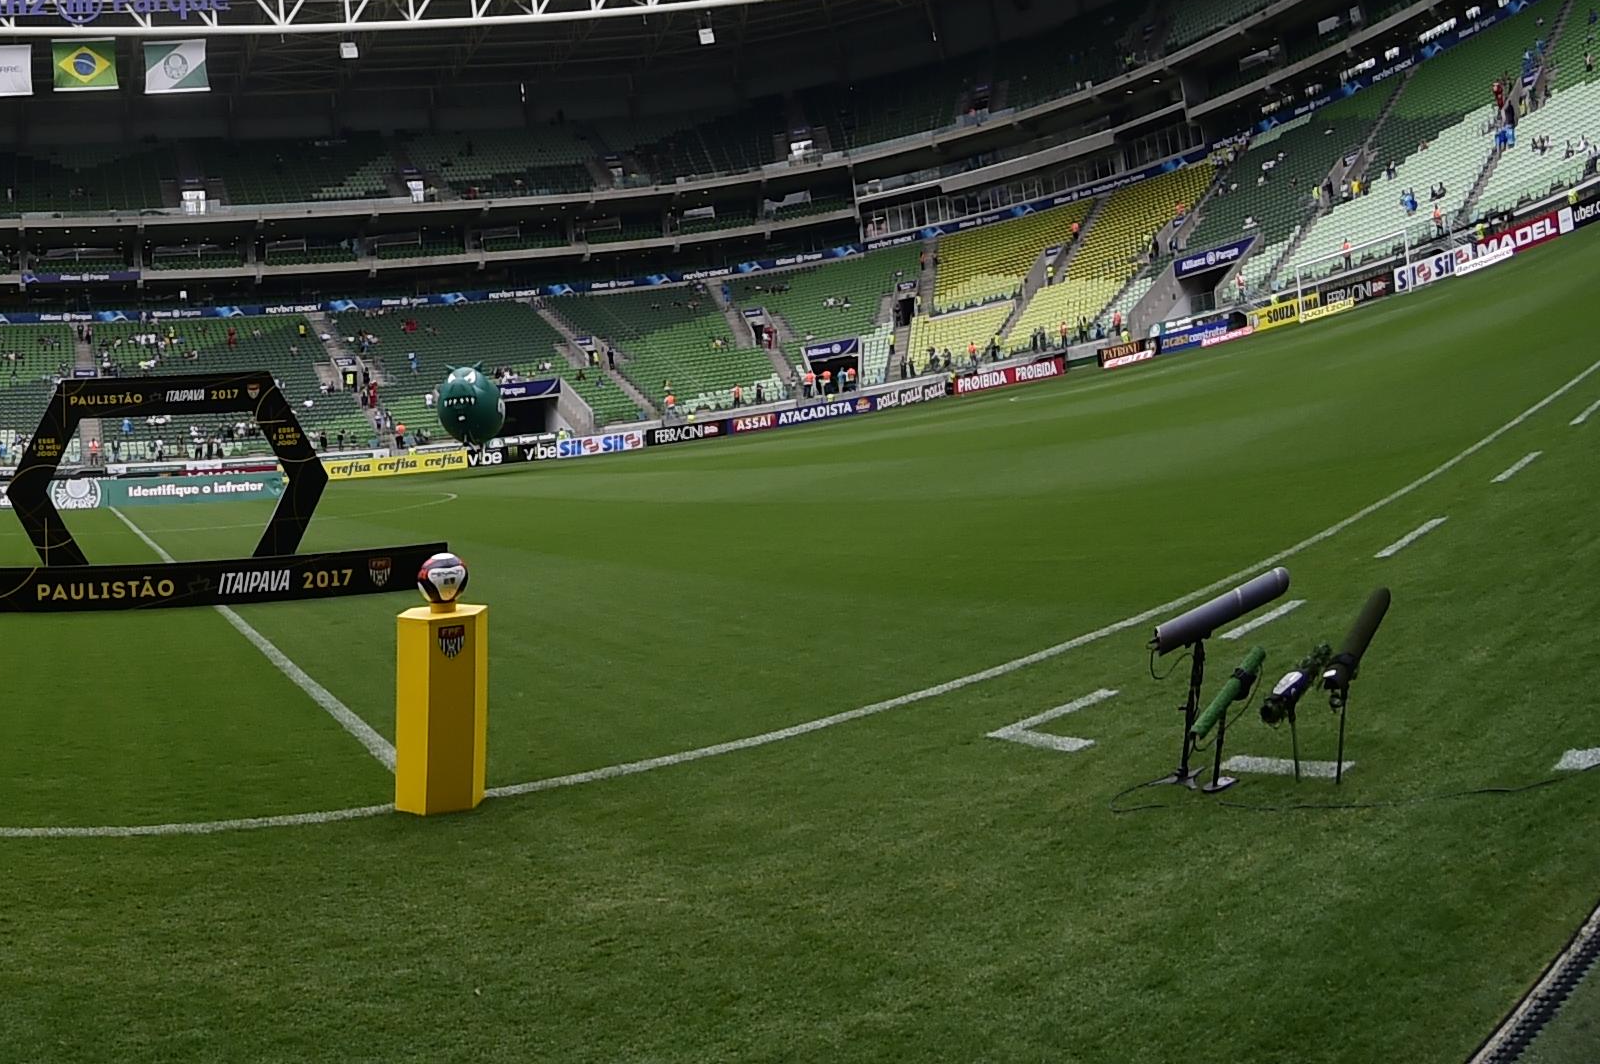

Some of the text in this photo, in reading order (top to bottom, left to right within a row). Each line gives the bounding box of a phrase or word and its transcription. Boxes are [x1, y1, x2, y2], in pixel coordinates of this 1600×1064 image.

[1477, 218, 1558, 258] MADEL
[1181, 247, 1239, 271] Allianz Parque
[1435, 253, 1455, 278] Sil
[1266, 303, 1296, 324] SOUZA
[70, 388, 239, 406] PAULISTÃO ITAIPAVA 2017
[876, 390, 900, 410] DOLLY
[901, 385, 923, 406] DOLLY
[924, 380, 946, 401] DOLLY
[778, 402, 853, 425] ATACADISTA
[559, 433, 625, 457] Sil Sil
[654, 424, 704, 445] FERRACINI
[330, 461, 371, 476] crefisa
[377, 457, 418, 473] crefisa
[424, 453, 464, 470] crefisa
[128, 481, 264, 498] Identifique o infrator
[37, 568, 353, 601] PAULISTÃO ITAIPAVA 2017
[441, 626, 462, 635] FPF
